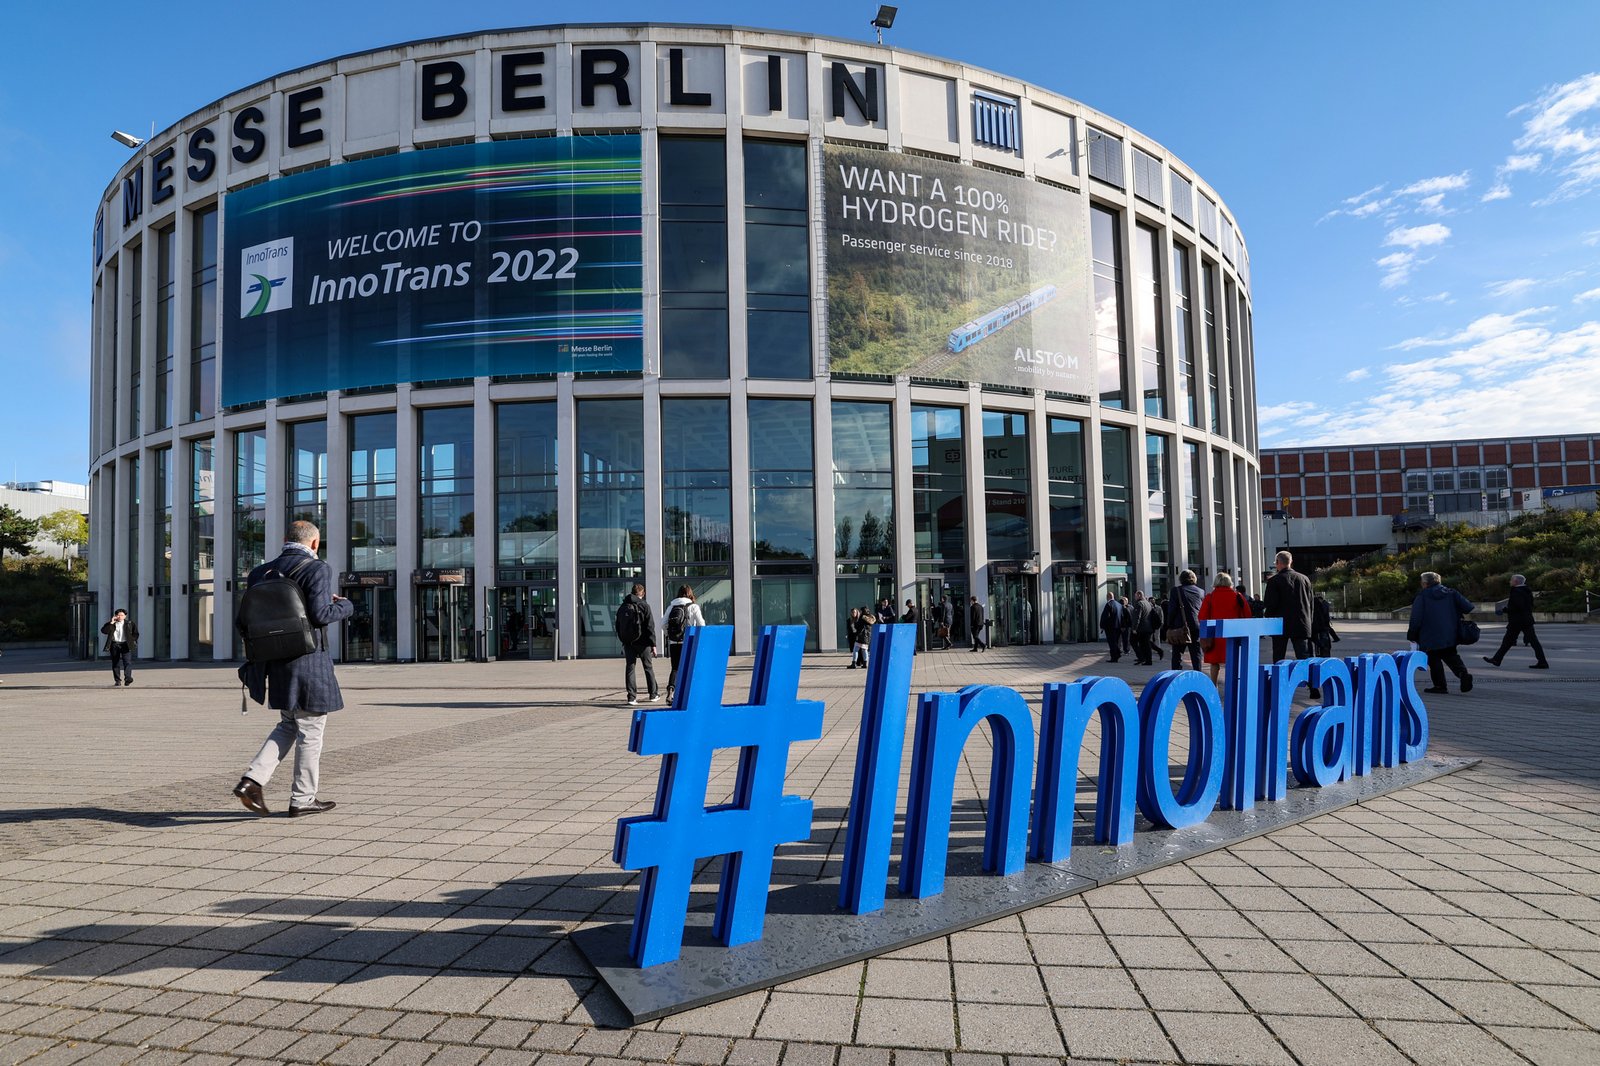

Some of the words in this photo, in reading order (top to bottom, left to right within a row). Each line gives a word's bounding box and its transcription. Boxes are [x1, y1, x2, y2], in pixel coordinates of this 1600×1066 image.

[123, 86, 323, 227] MESSE
[422, 48, 878, 121] BERLIN
[839, 164, 922, 197] WANT
[930, 178, 946, 202] A
[954, 185, 1008, 214] 100%
[327, 224, 442, 260] WELCOME
[449, 220, 482, 243] TO
[842, 195, 988, 239] HYDROGEN
[998, 219, 1057, 252] RIDE?
[246, 244, 289, 265] InnoTrans
[842, 234, 906, 254] Passenger
[910, 242, 950, 259] service
[954, 249, 982, 264] since
[986, 254, 1013, 269] 2018
[309, 260, 472, 306] InnoTrans
[486, 247, 580, 284] 2022
[593, 344, 613, 352] Berlin
[1014, 347, 1079, 370] ALSTOM
[1017, 365, 1046, 376] mobility
[1046, 368, 1055, 378] by
[983, 448, 1009, 459] RC
[1004, 467, 1026, 476] BETT
[1048, 465, 1074, 474] TURE
[612, 617, 1428, 968] #InnoTrans
